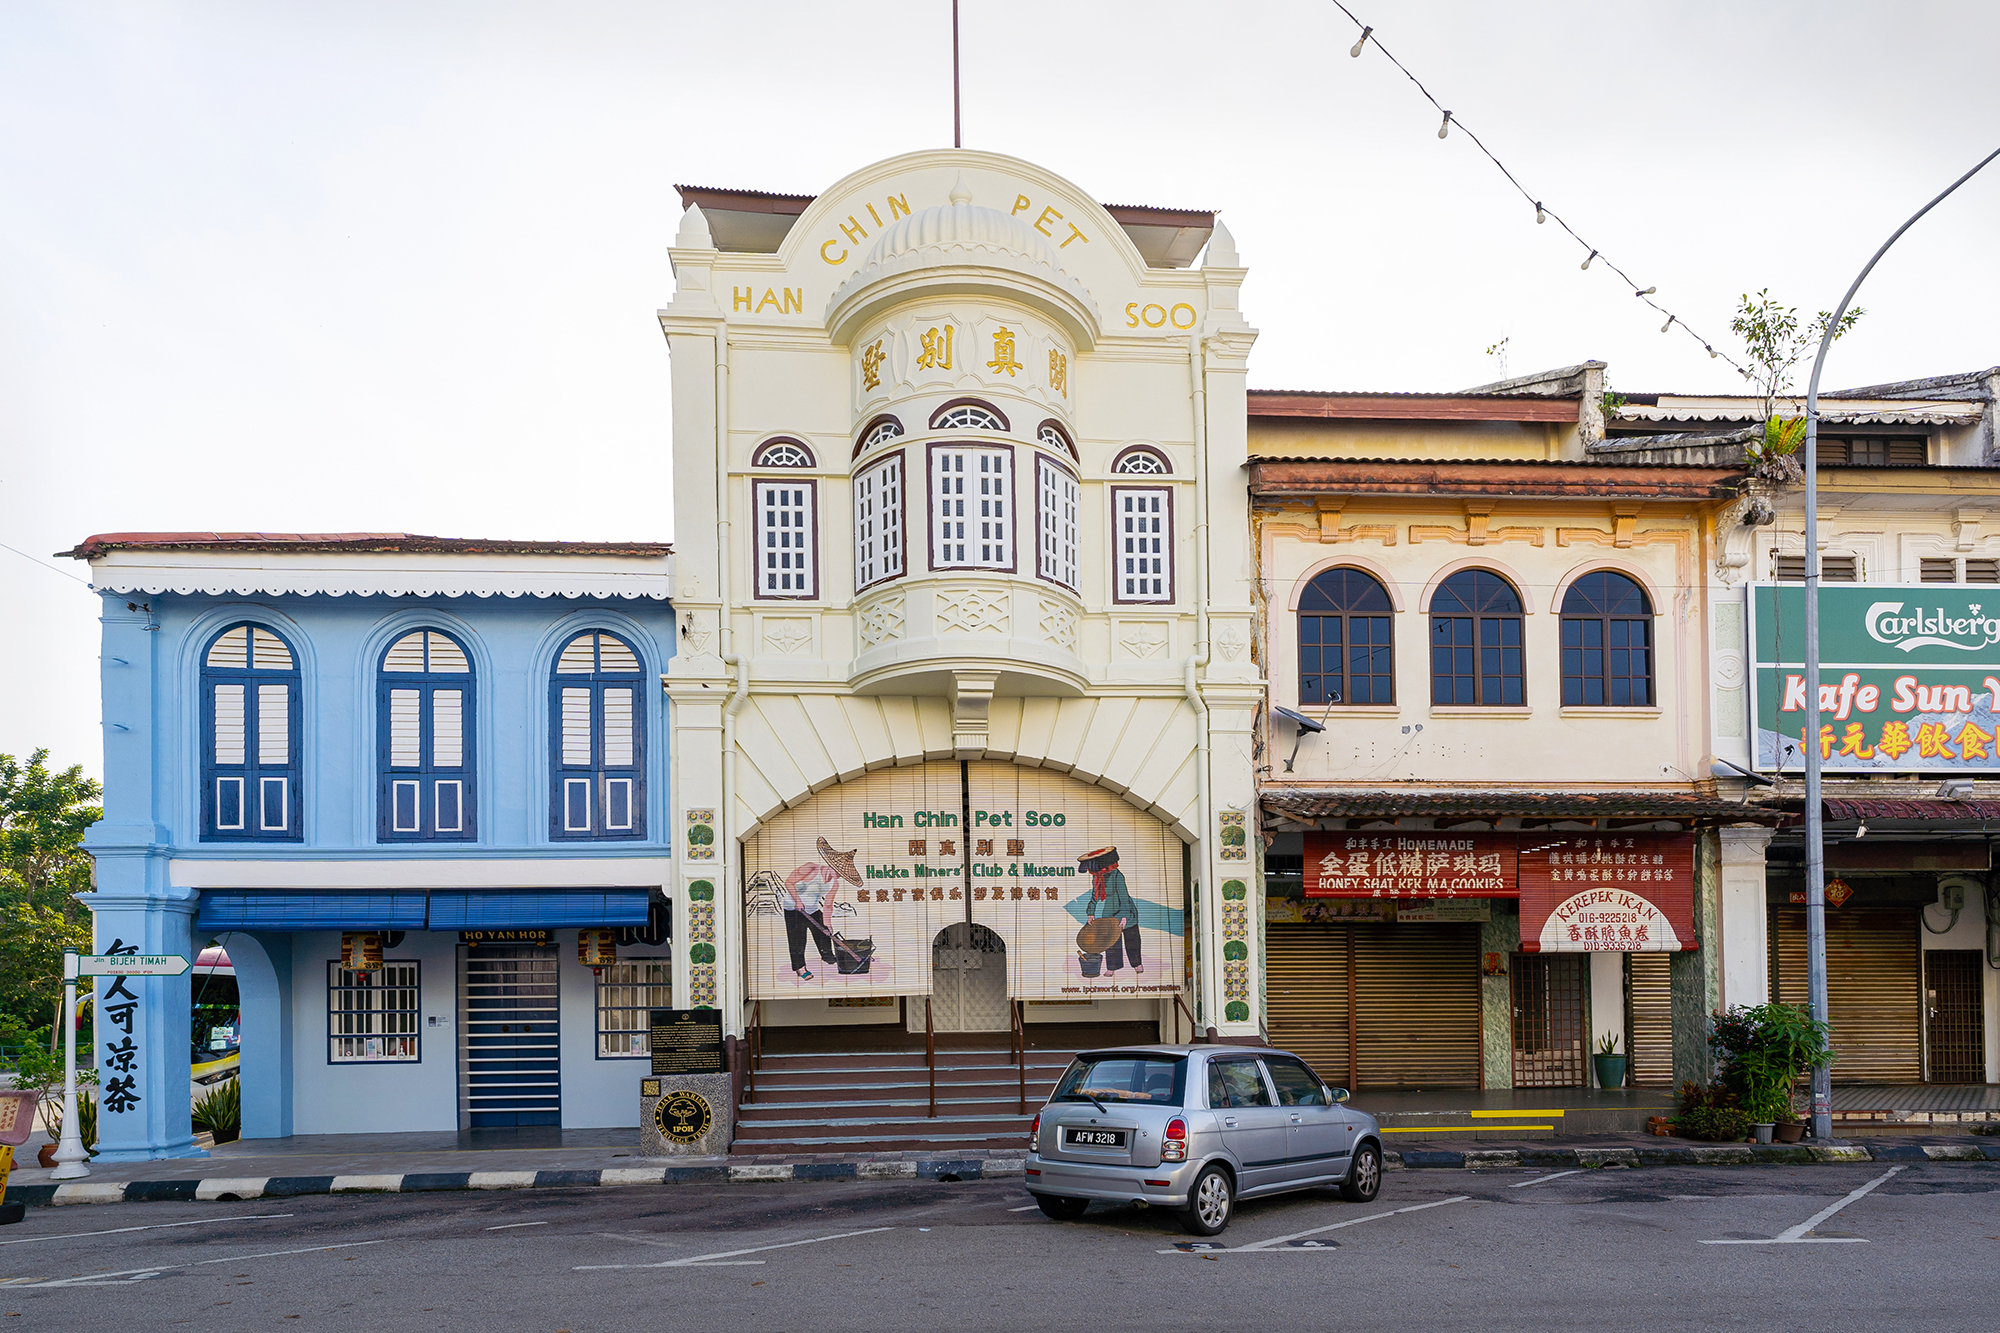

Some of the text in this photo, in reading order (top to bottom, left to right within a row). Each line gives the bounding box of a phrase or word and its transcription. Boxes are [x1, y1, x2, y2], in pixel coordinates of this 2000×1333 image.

[733, 192, 1197, 330] HAN CHIN PET SOO
[1865, 602, 2000, 652] Carlsberg
[1891, 675, 1973, 713] Sun
[1799, 721, 2000, 760] 新元華飲食
[863, 810, 1066, 828] Han Chin Pet Soo
[1398, 837, 1474, 850] HOMEMADE
[866, 864, 910, 879] Hakka
[972, 863, 1003, 877] Club
[1007, 863, 1018, 877] &
[1023, 863, 1075, 877] Museum
[1318, 851, 1502, 877] 全蛋低糖萨琪玛
[1318, 878, 1360, 889] HONEY
[1363, 878, 1395, 889] SHAT
[1427, 878, 1448, 889] MA
[1451, 878, 1504, 889] COOKIES
[1556, 891, 1658, 923] KEREPEK IKAN
[1578, 912, 1638, 923] 016-9225218
[465, 930, 546, 940] HO YAN HOR
[110, 957, 136, 966] BIJEH
[140, 957, 167, 966] TIMAH
[672, 1125, 694, 1133] IPOH
[1075, 1131, 1116, 1144] AFW 3218
